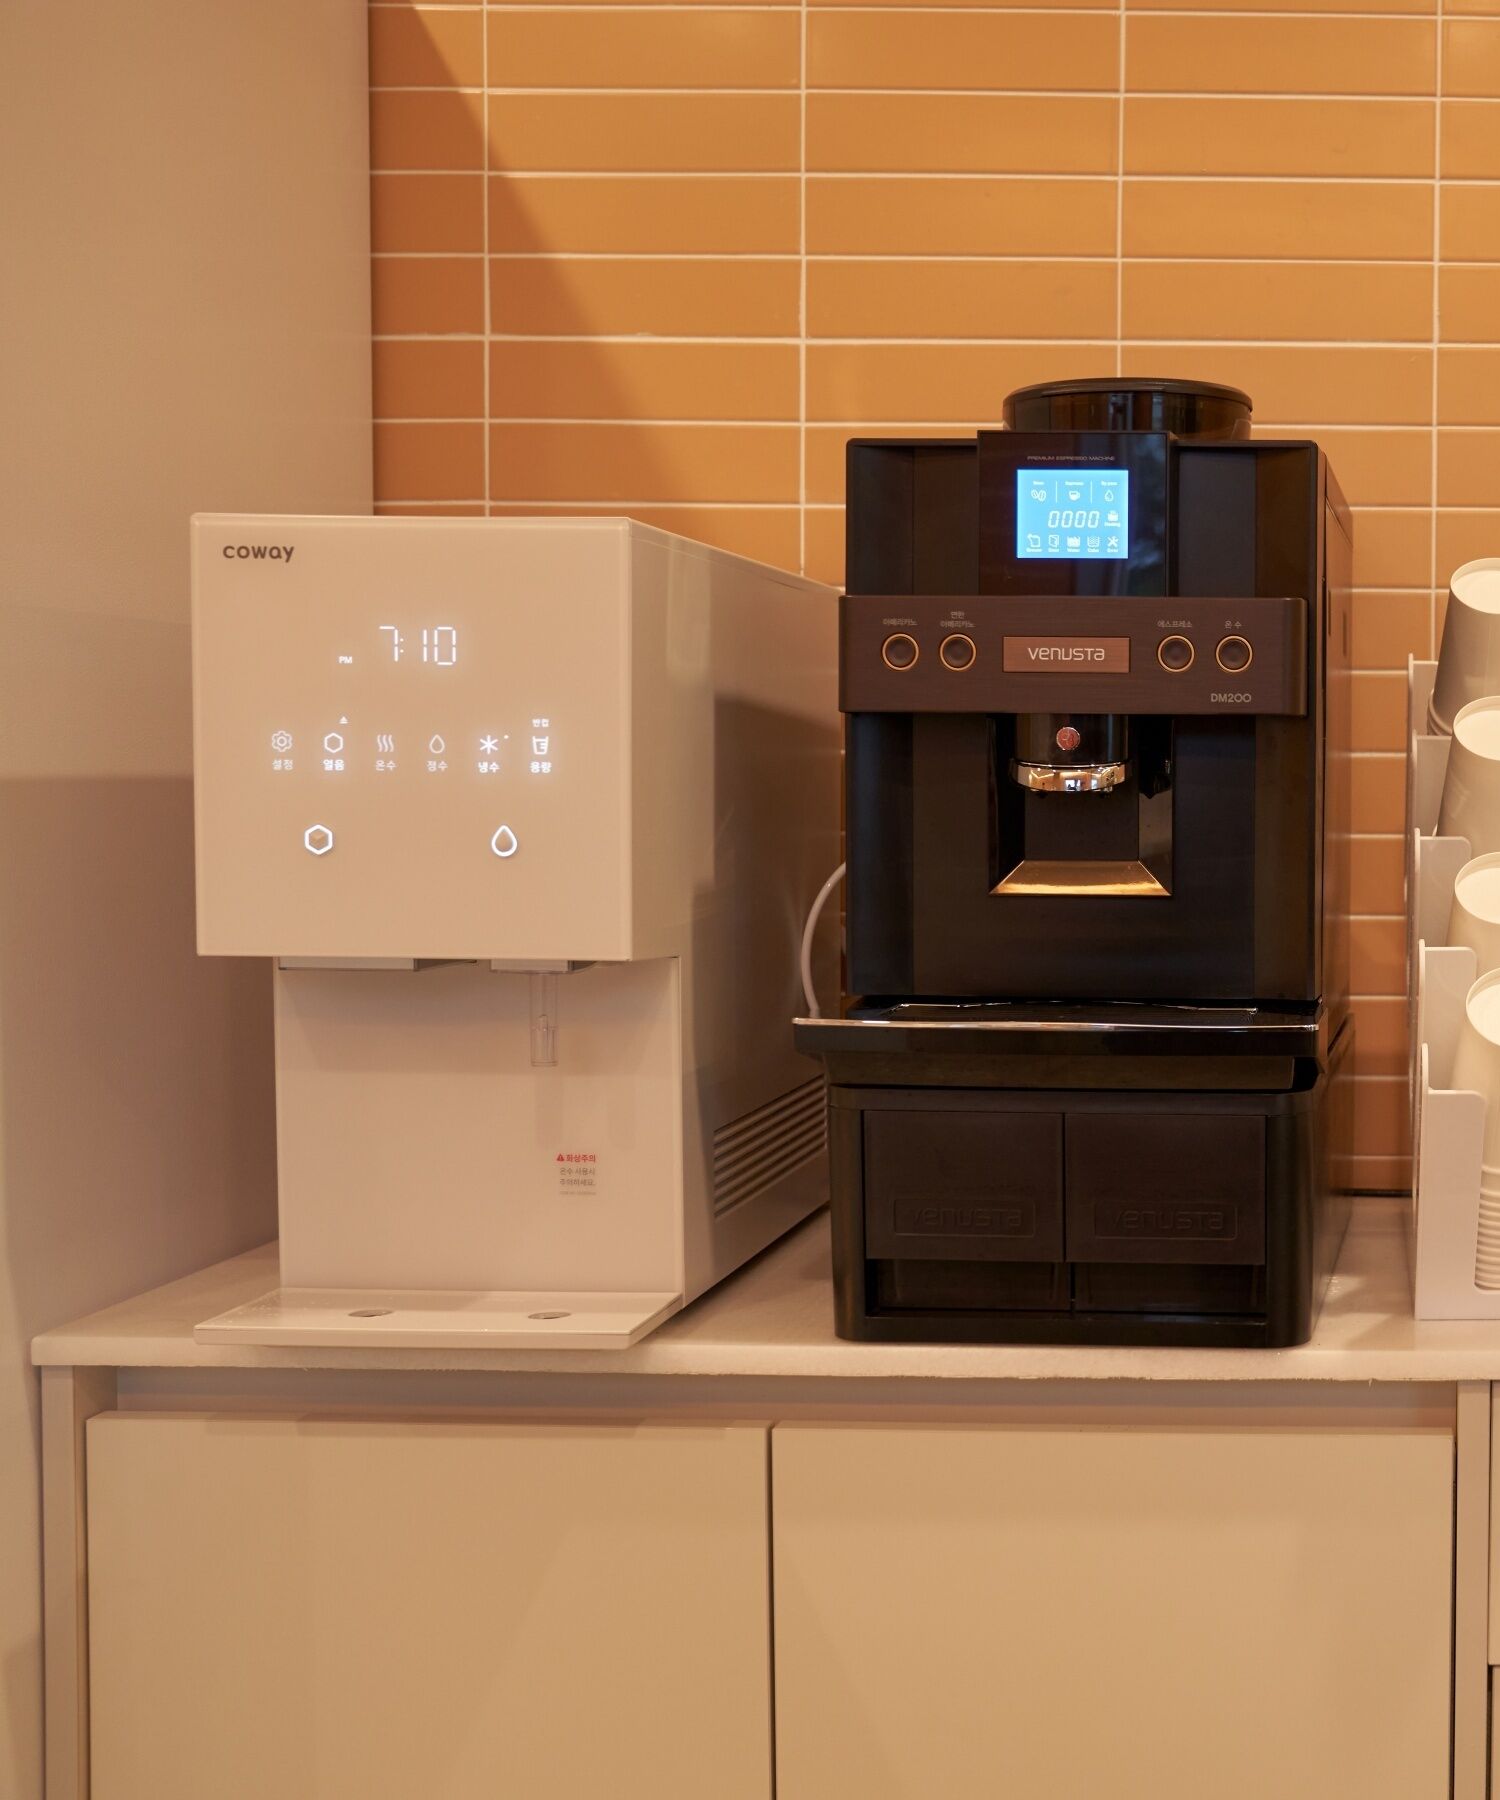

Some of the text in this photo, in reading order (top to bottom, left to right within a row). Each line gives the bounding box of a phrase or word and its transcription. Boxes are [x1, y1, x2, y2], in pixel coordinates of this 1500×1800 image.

[1048, 510, 1100, 528] 0000
[222, 544, 296, 563] coway
[1157, 619, 1193, 628] 에스프레소
[378, 625, 457, 666] 7:10
[338, 656, 353, 664] PM
[1210, 693, 1252, 703] DM200
[272, 759, 294, 771] 설정
[322, 759, 345, 771] 얼음
[375, 760, 397, 772] 온수
[426, 760, 448, 772] 정수
[478, 761, 500, 774] 냉수
[530, 761, 552, 774] 용량
[566, 1153, 596, 1163] 화상주의
